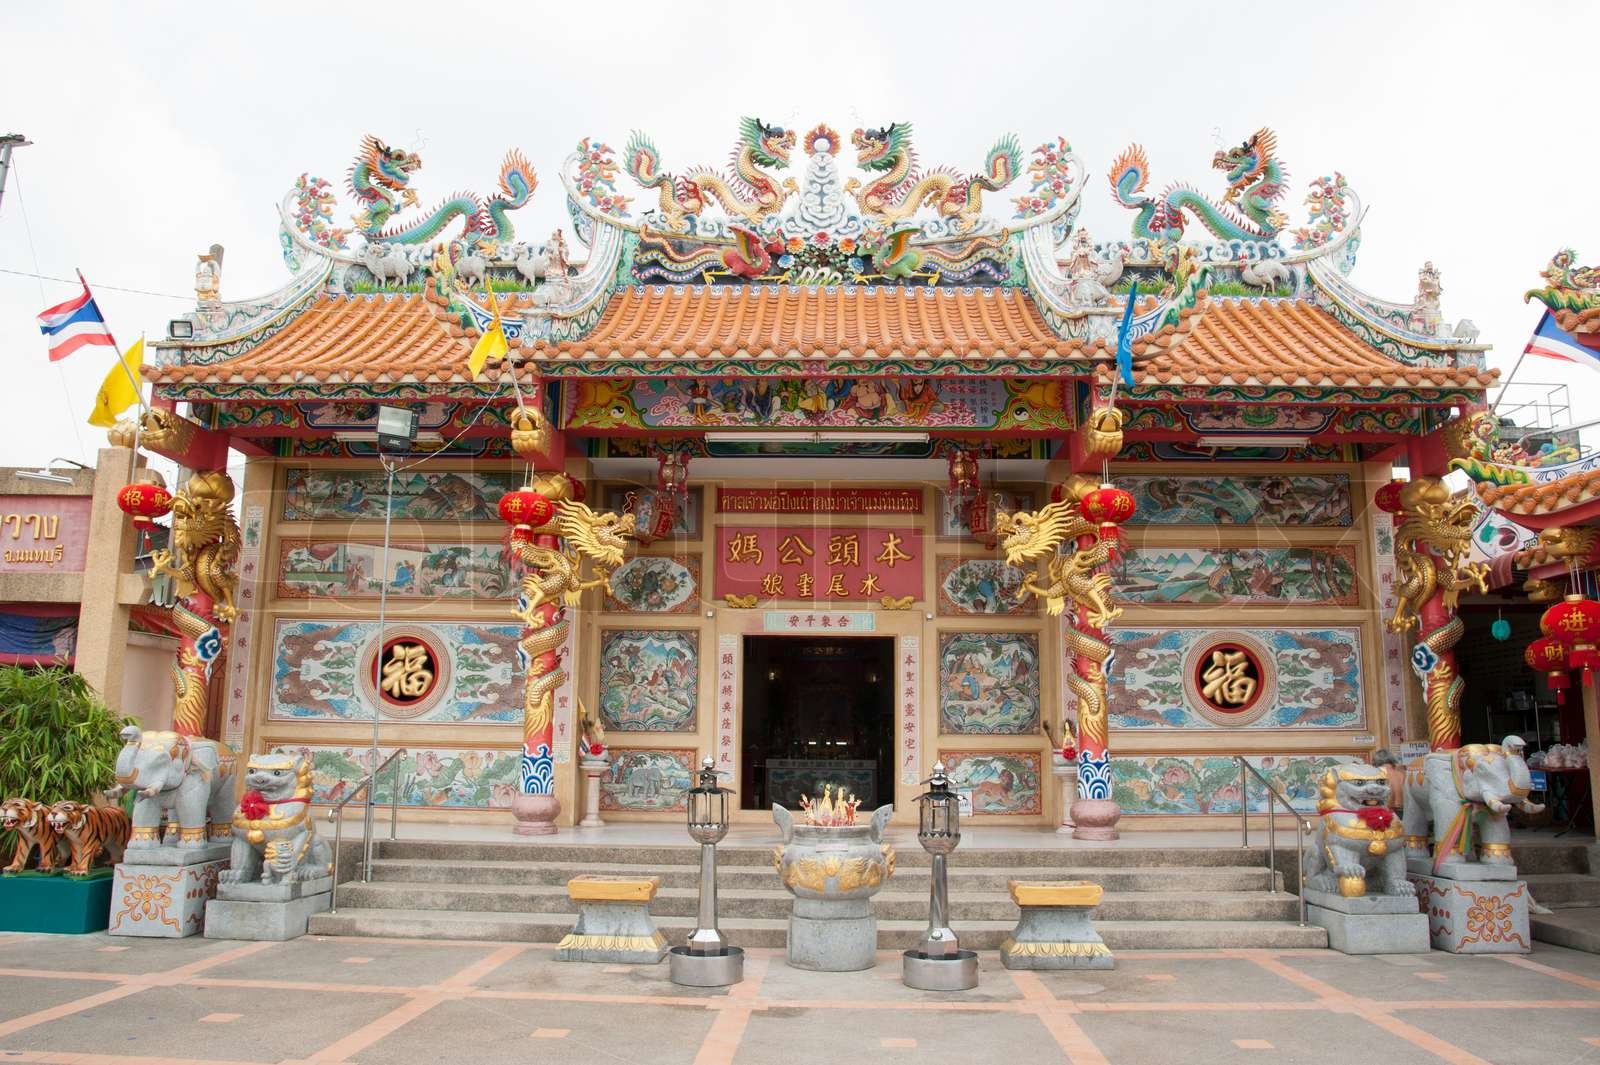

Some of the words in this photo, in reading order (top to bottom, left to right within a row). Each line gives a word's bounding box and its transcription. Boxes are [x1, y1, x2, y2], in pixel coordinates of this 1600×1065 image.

[1563, 609, 1589, 632] 进
[381, 644, 435, 699] 福
[1202, 650, 1258, 706] 福
